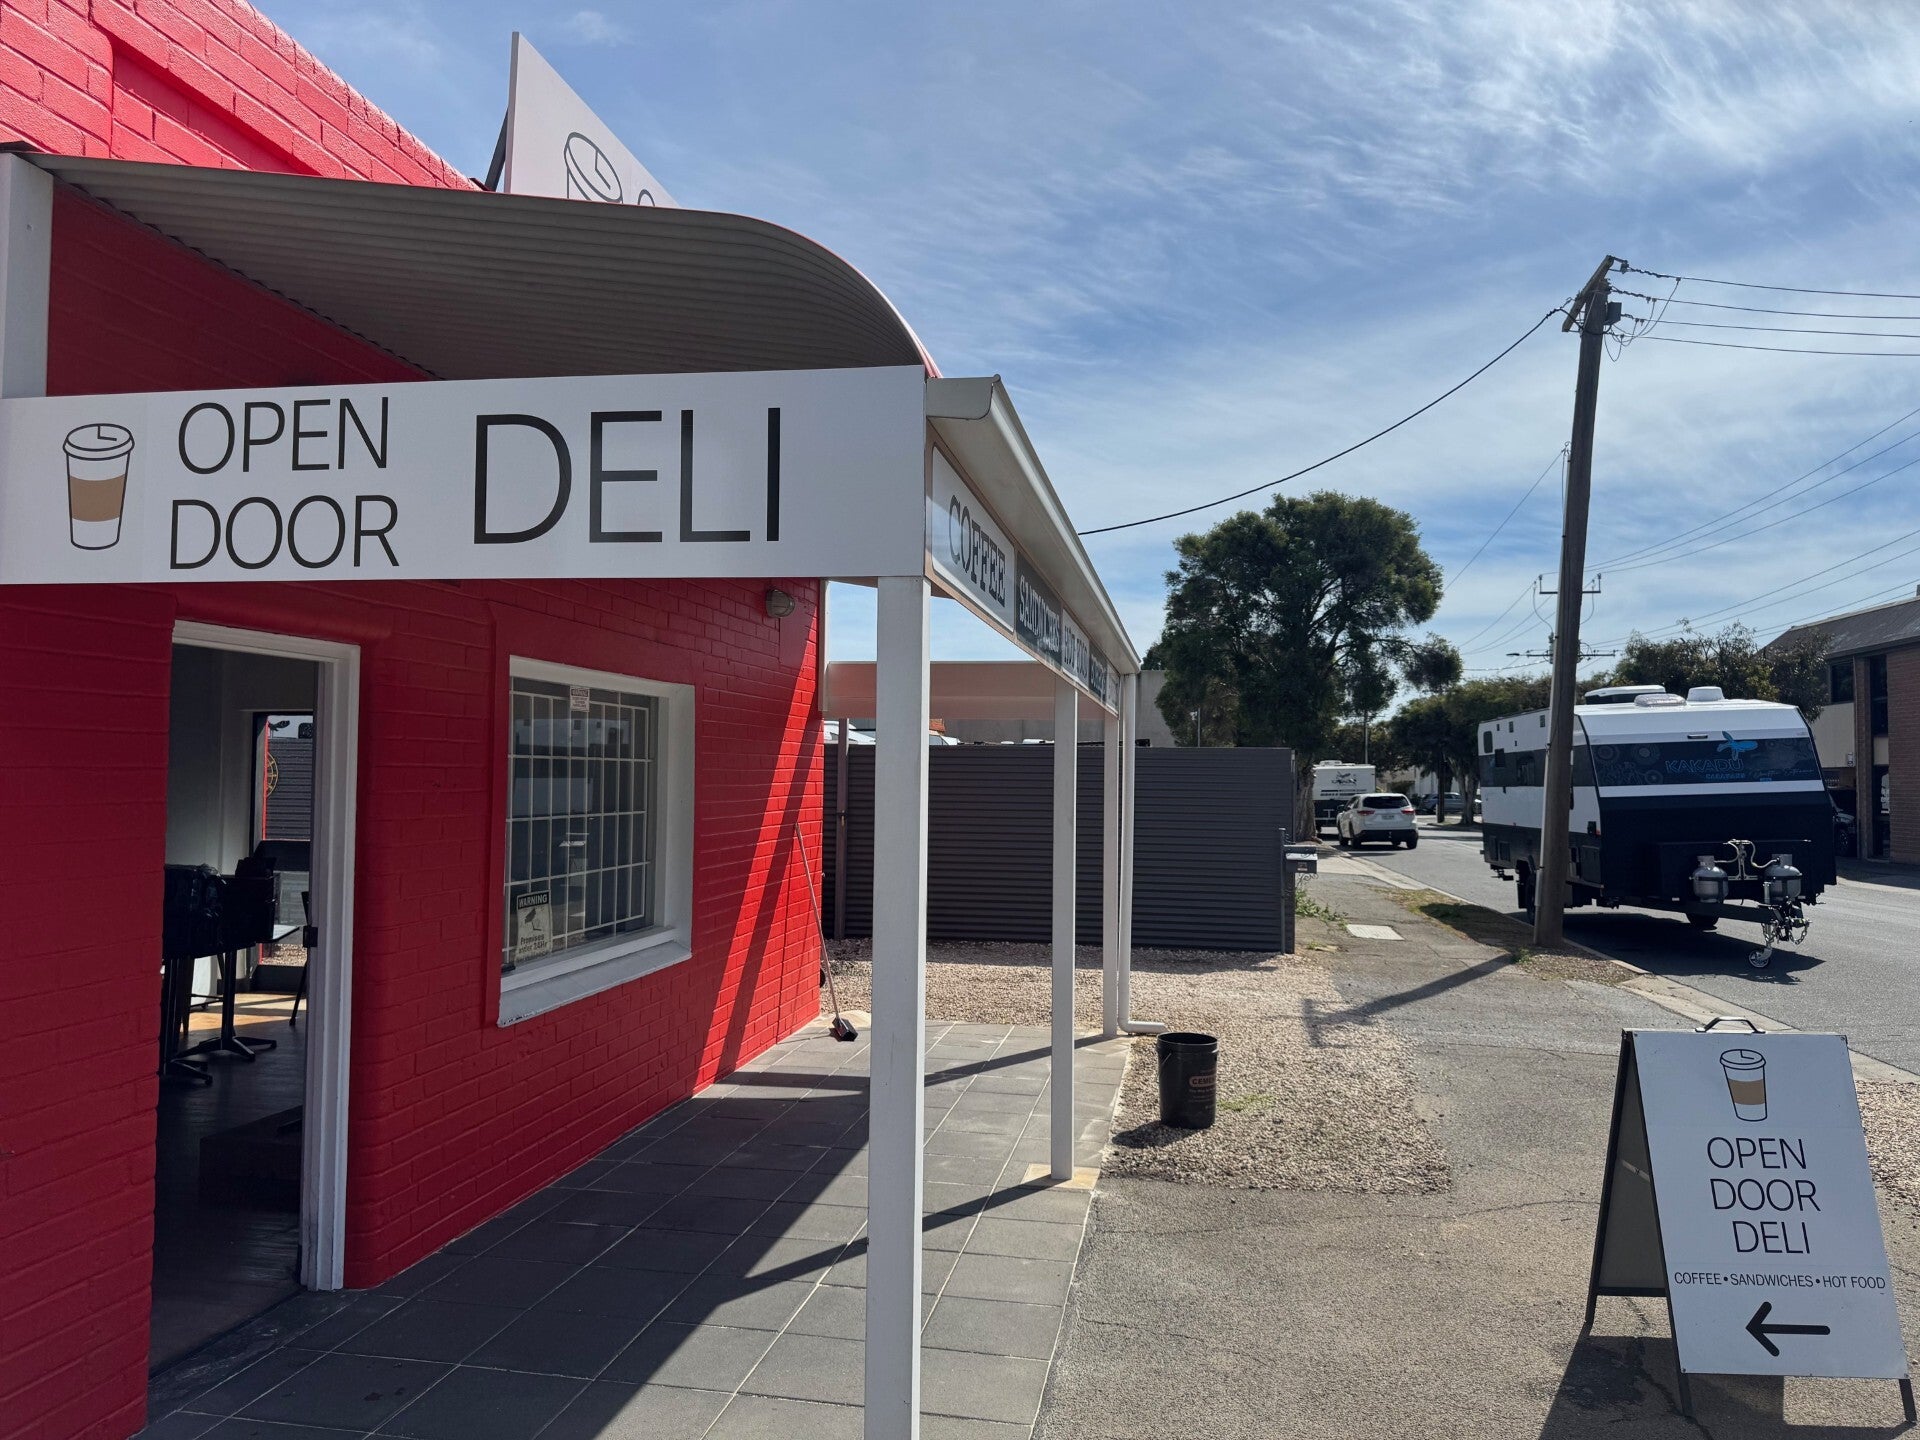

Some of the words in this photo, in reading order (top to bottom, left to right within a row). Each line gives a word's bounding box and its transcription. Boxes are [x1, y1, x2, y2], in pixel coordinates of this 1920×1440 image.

[178, 397, 389, 475] OPEN
[474, 407, 780, 544] DELI
[170, 495, 400, 569] DOOR
[949, 494, 1006, 608] COFFEE
[1665, 758, 1743, 773] KAKADU
[519, 894, 547, 907] WARNING
[1706, 1136, 1807, 1169] OPEN
[1710, 1178, 1821, 1212] DOOR
[1732, 1220, 1811, 1254] DELI
[1674, 1271, 1722, 1285] COFFEE
[1730, 1273, 1814, 1288] SANDWICHES
[1822, 1275, 1848, 1288] HOT
[1851, 1276, 1886, 1289] FOOD
